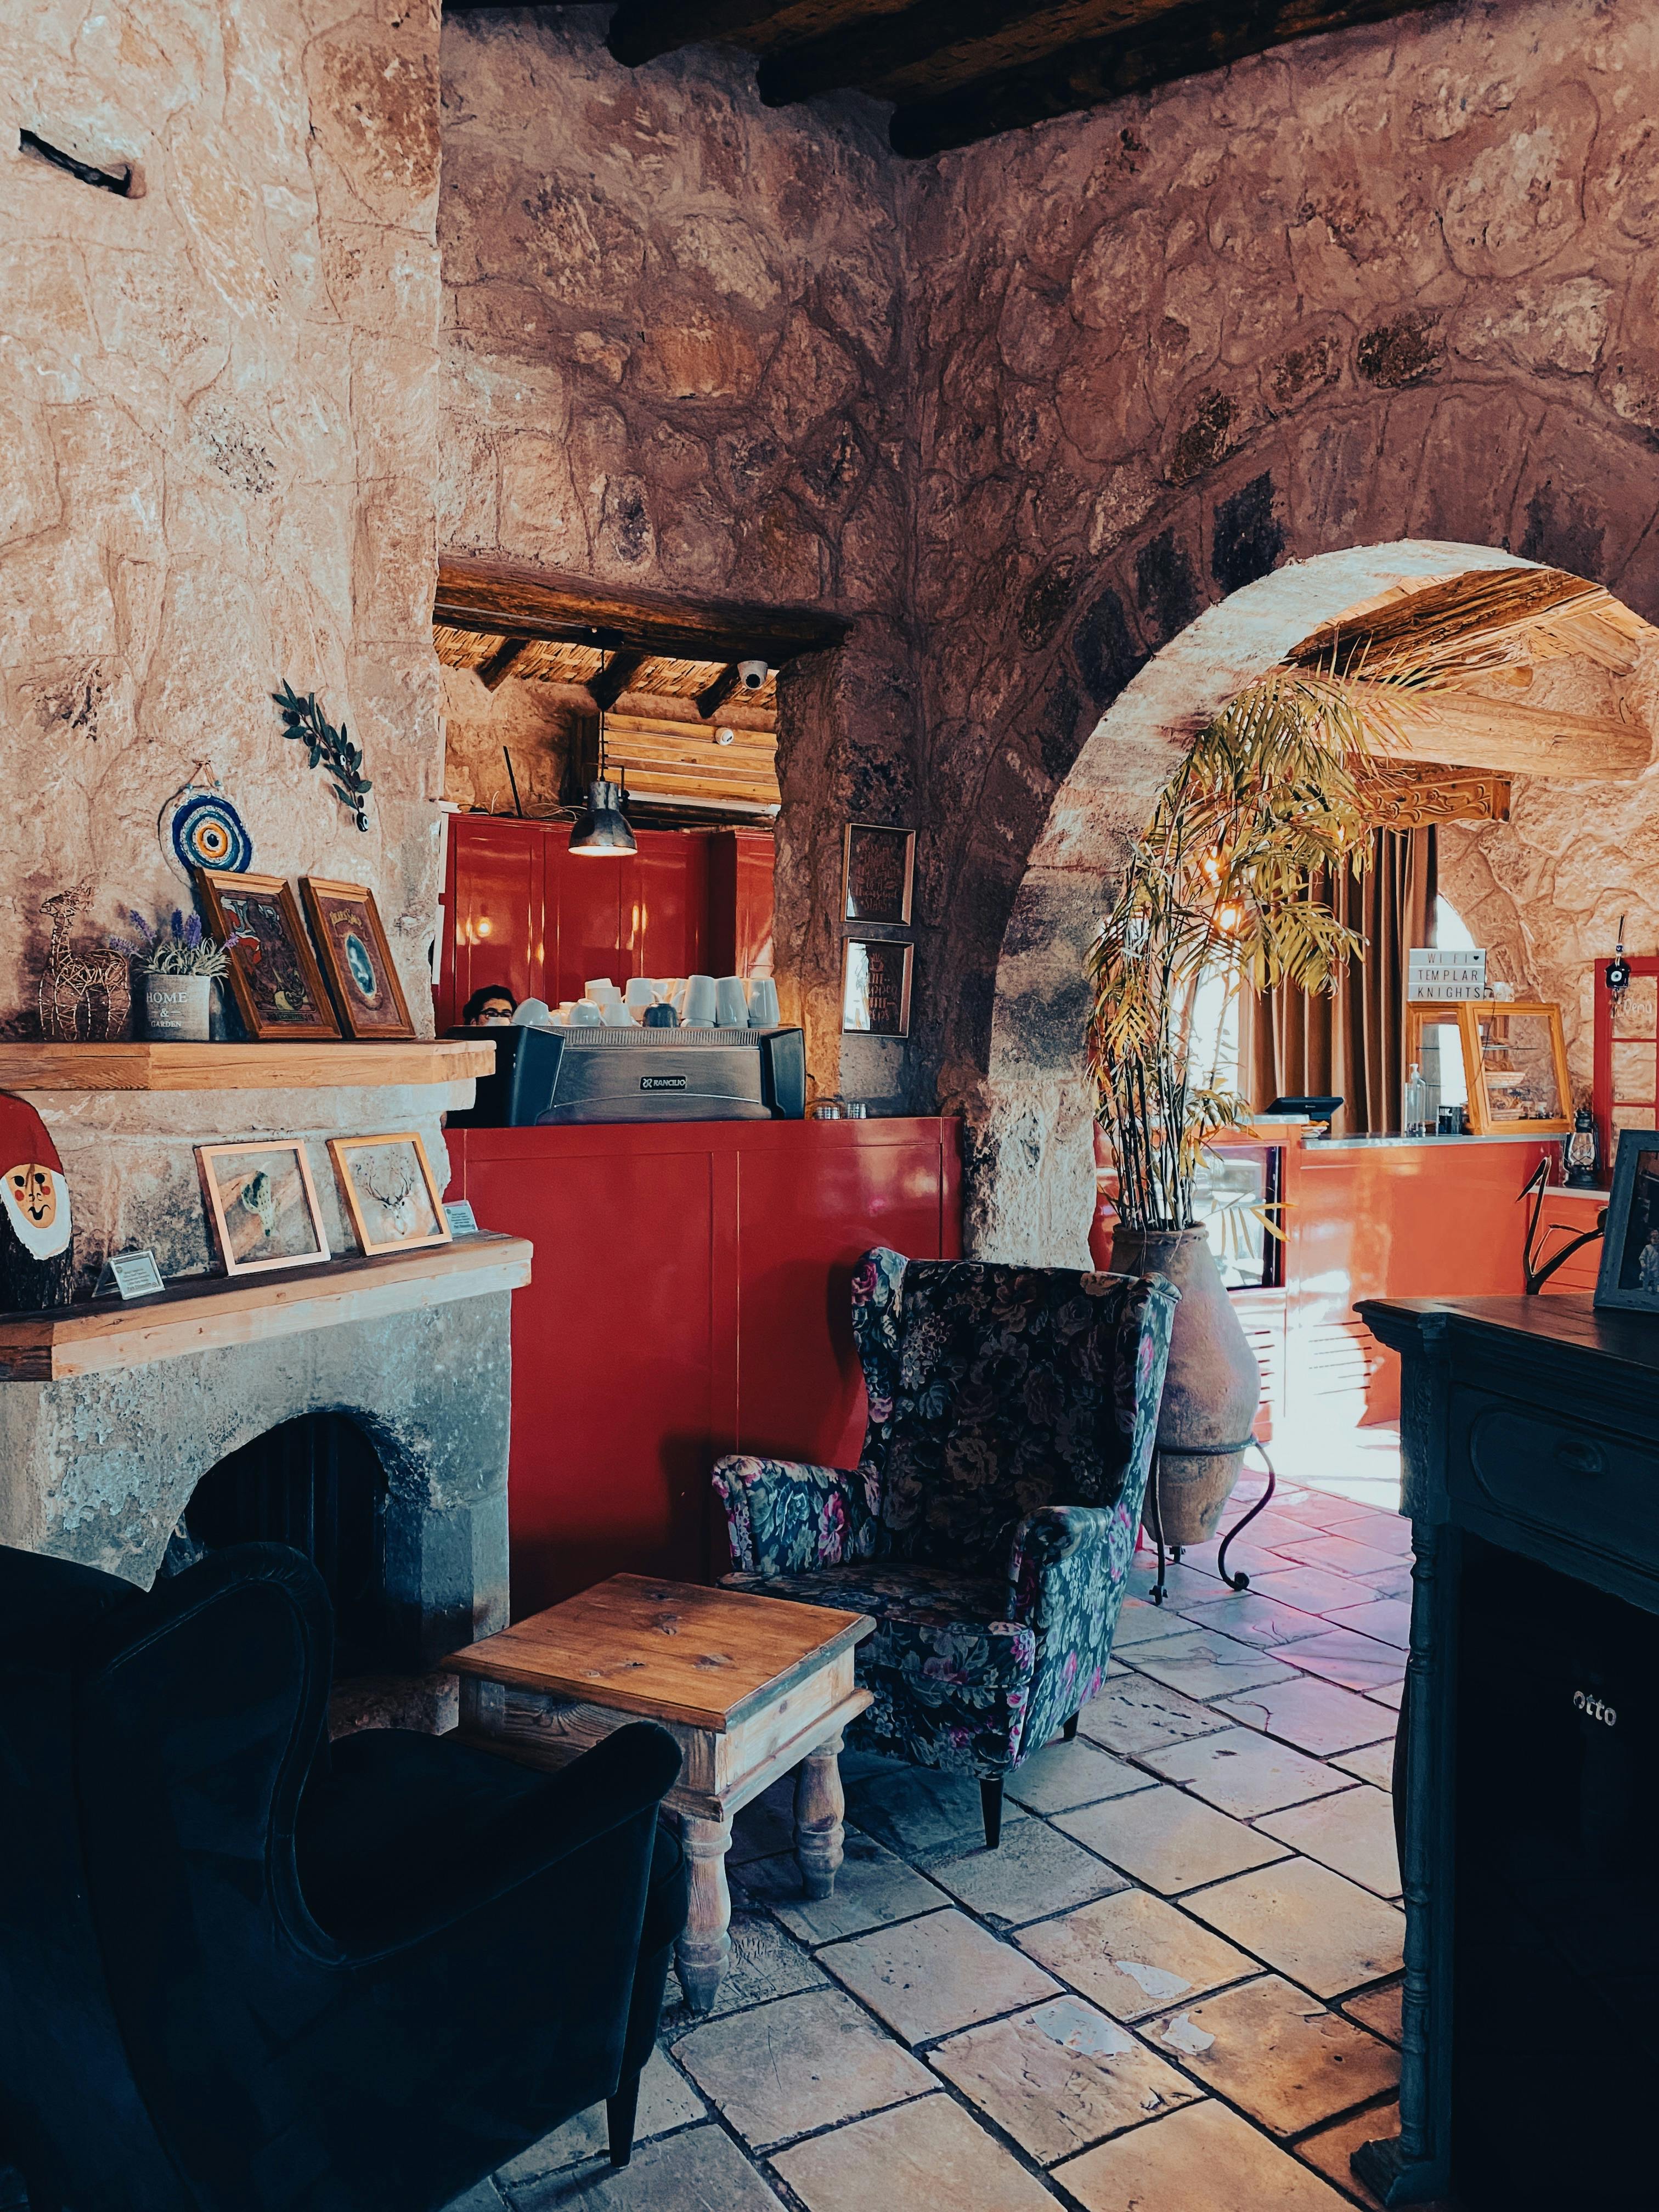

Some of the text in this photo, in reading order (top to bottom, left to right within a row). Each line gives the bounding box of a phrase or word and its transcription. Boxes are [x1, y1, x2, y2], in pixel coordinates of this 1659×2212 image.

[1418, 970, 1477, 981] TEMPLAR
[146, 992, 187, 1003] HOME
[1418, 987, 1480, 998] KNIGHTS
